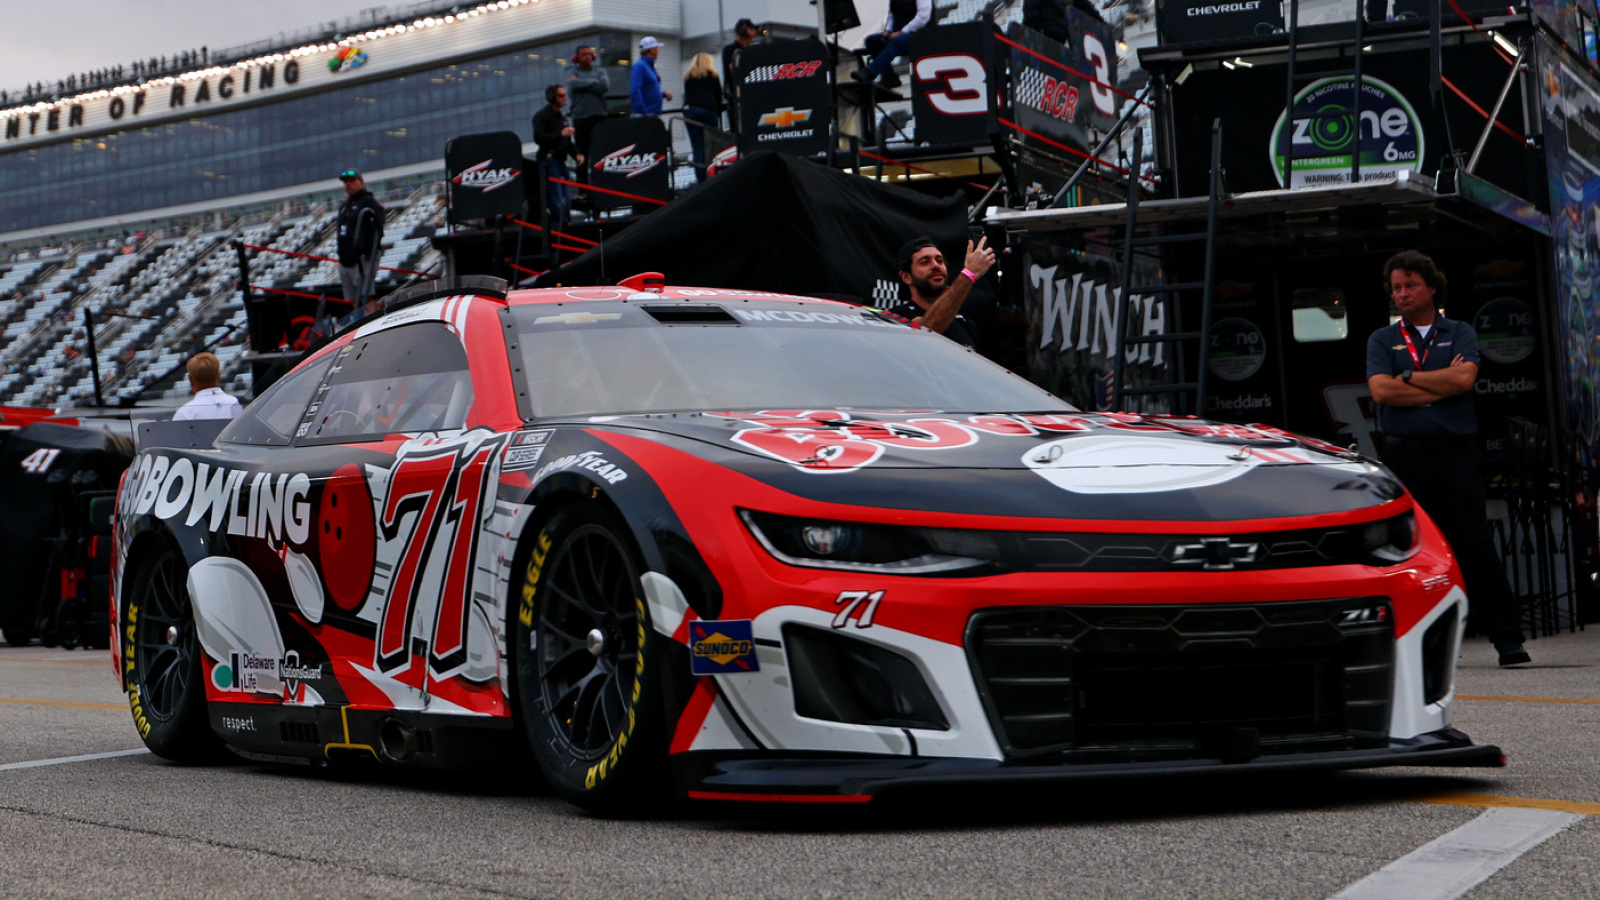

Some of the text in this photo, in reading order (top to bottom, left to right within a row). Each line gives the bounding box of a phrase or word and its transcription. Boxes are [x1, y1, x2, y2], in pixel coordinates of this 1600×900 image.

[1187, 0, 1261, 17] CHEVROLET
[1083, 31, 1115, 118] 3
[109, 91, 147, 120] OF
[170, 60, 299, 107] RACING
[914, 53, 988, 116] 3
[1350, 82, 1386, 99] PUCHES
[1041, 75, 1079, 124] RCR
[758, 129, 813, 141] CHEVROLET
[603, 152, 658, 168] HYAK
[461, 167, 513, 182] HYAK
[1304, 173, 1344, 184] WARNING:
[1364, 170, 1396, 182] product
[21, 447, 61, 473] 41
[531, 450, 629, 485] GOODYEAR
[377, 432, 503, 679] 71
[519, 528, 551, 628] EAGLE
[832, 590, 886, 629] 71
[694, 639, 753, 657] SUNOCO
[243, 653, 275, 670] Delaware
[280, 663, 323, 679] NationsGuard
[243, 673, 257, 690] Life
